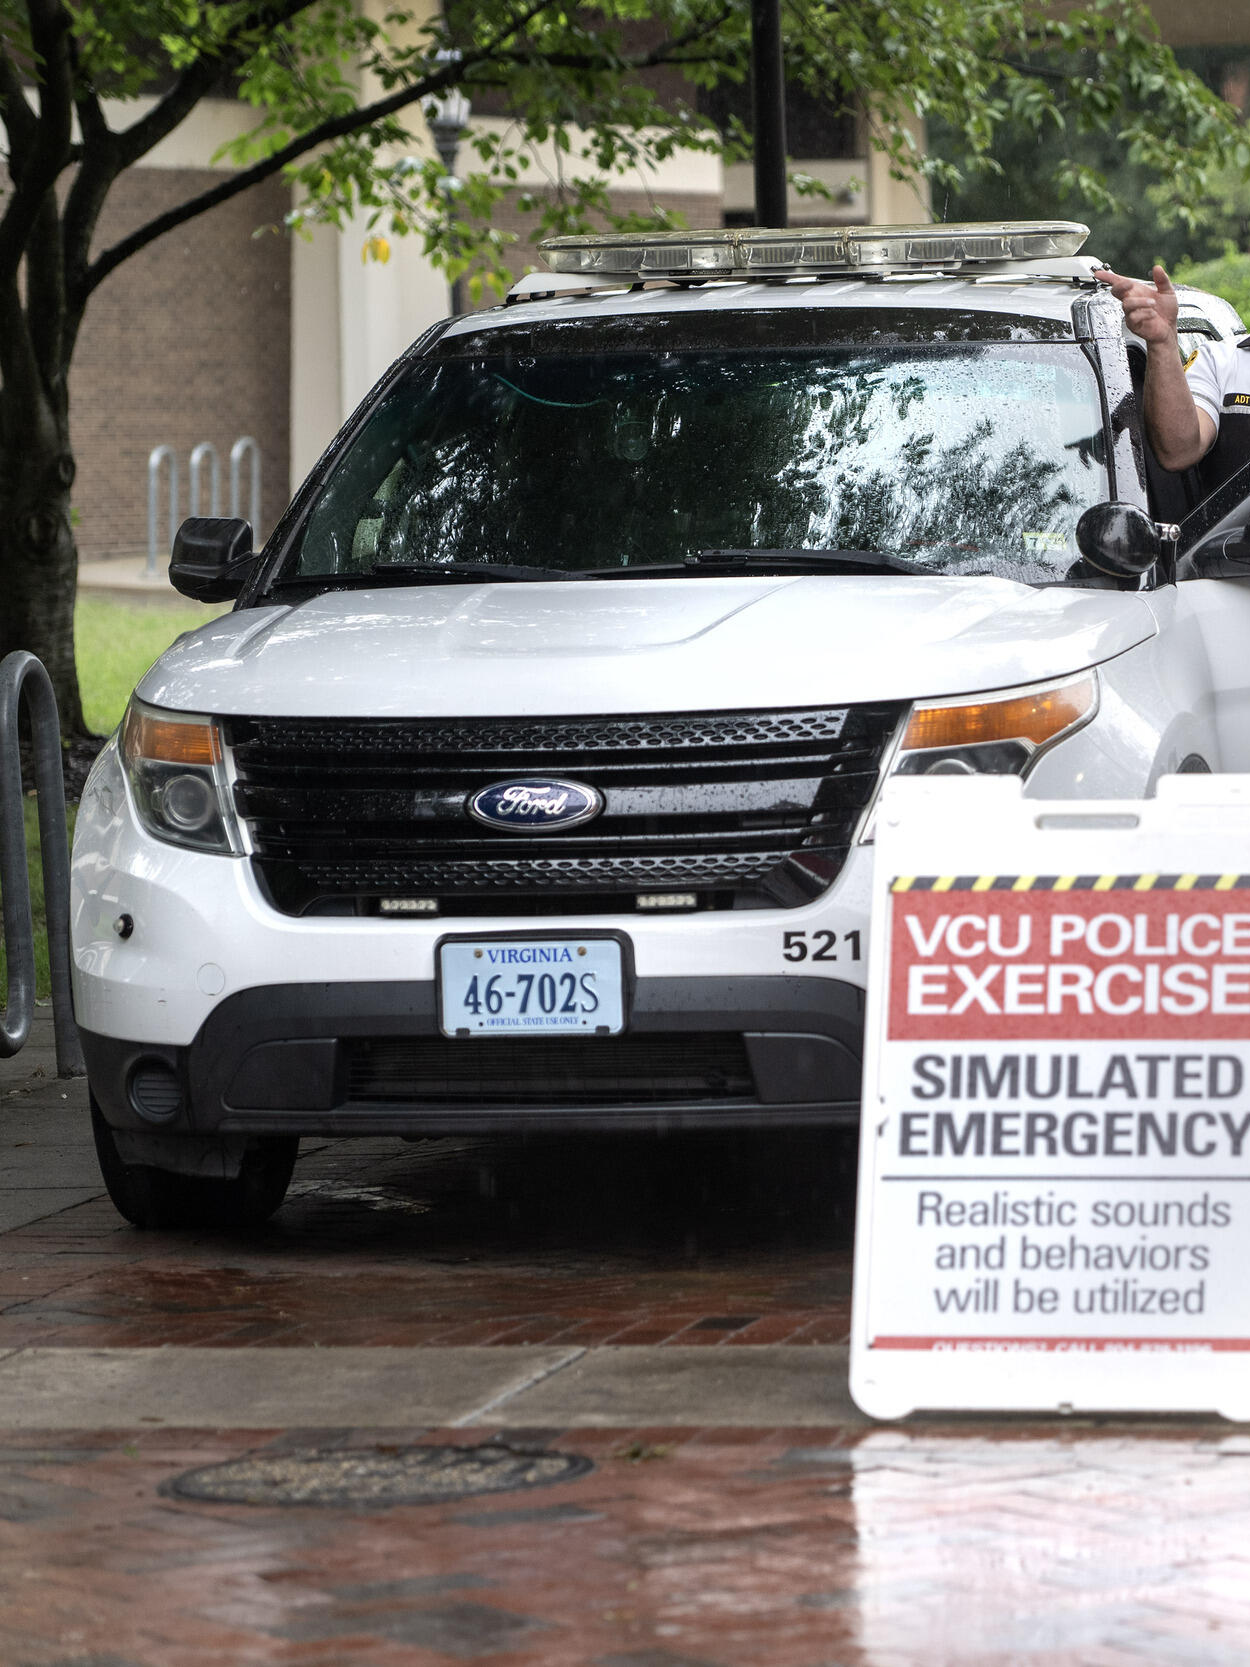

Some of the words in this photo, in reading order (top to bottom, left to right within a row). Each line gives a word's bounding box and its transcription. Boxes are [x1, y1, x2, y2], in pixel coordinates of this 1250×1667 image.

[1234, 395, 1250, 404] ADT
[496, 786, 569, 815] Ford
[783, 930, 861, 962] 521
[905, 915, 1031, 956] VCU
[487, 947, 573, 964] VIRGINIA
[463, 972, 599, 1015] 46-702S
[522, 1017, 545, 1026] STATE
[911, 1055, 1244, 1099] SIMULATED
[917, 1192, 1077, 1227] Realistic
[1091, 1192, 1232, 1228] sounds
[935, 1236, 1006, 1270] and
[1020, 1236, 1210, 1271] behaviors
[934, 1279, 999, 1313] will
[1013, 1279, 1060, 1314] be
[1073, 1279, 1205, 1315] utilized
